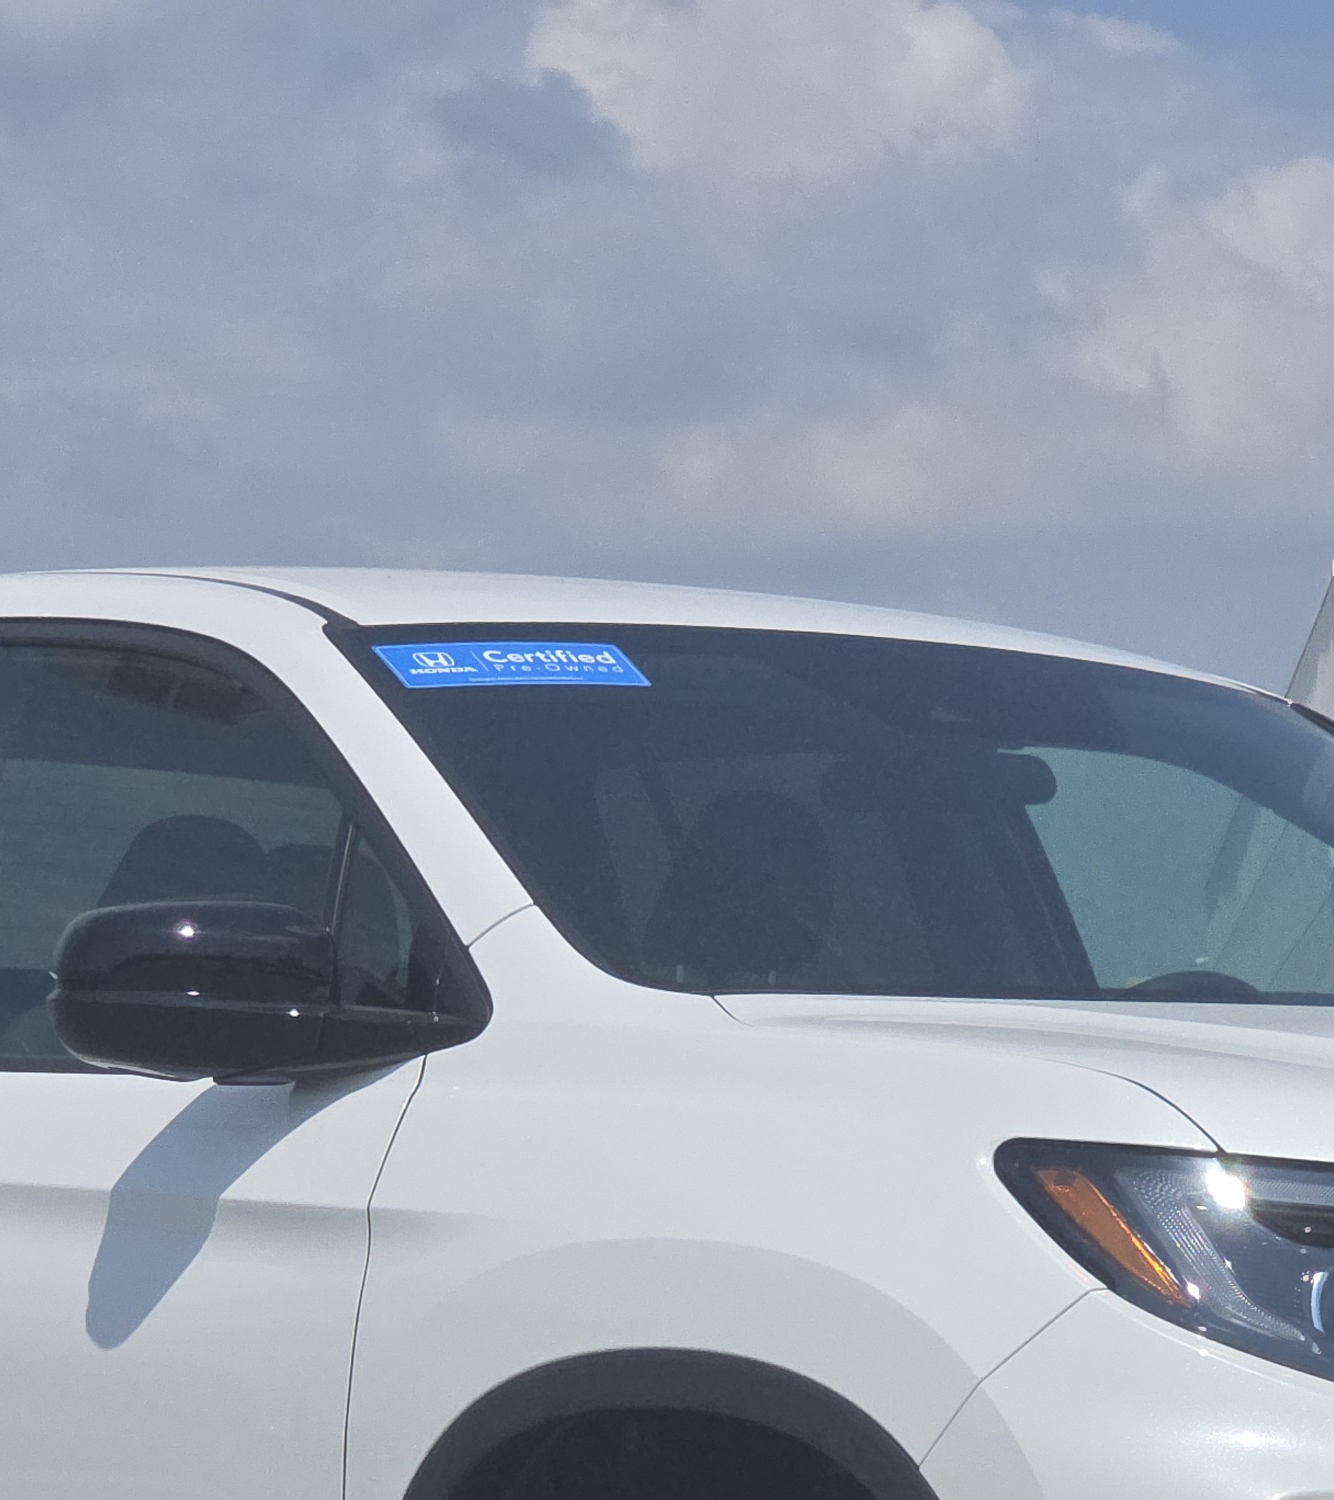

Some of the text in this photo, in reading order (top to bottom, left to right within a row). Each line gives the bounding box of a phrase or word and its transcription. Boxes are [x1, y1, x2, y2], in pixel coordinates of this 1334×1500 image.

[483, 650, 617, 665] Certified
[409, 667, 478, 675] HONDA
[493, 663, 624, 673] Pre-Owned
